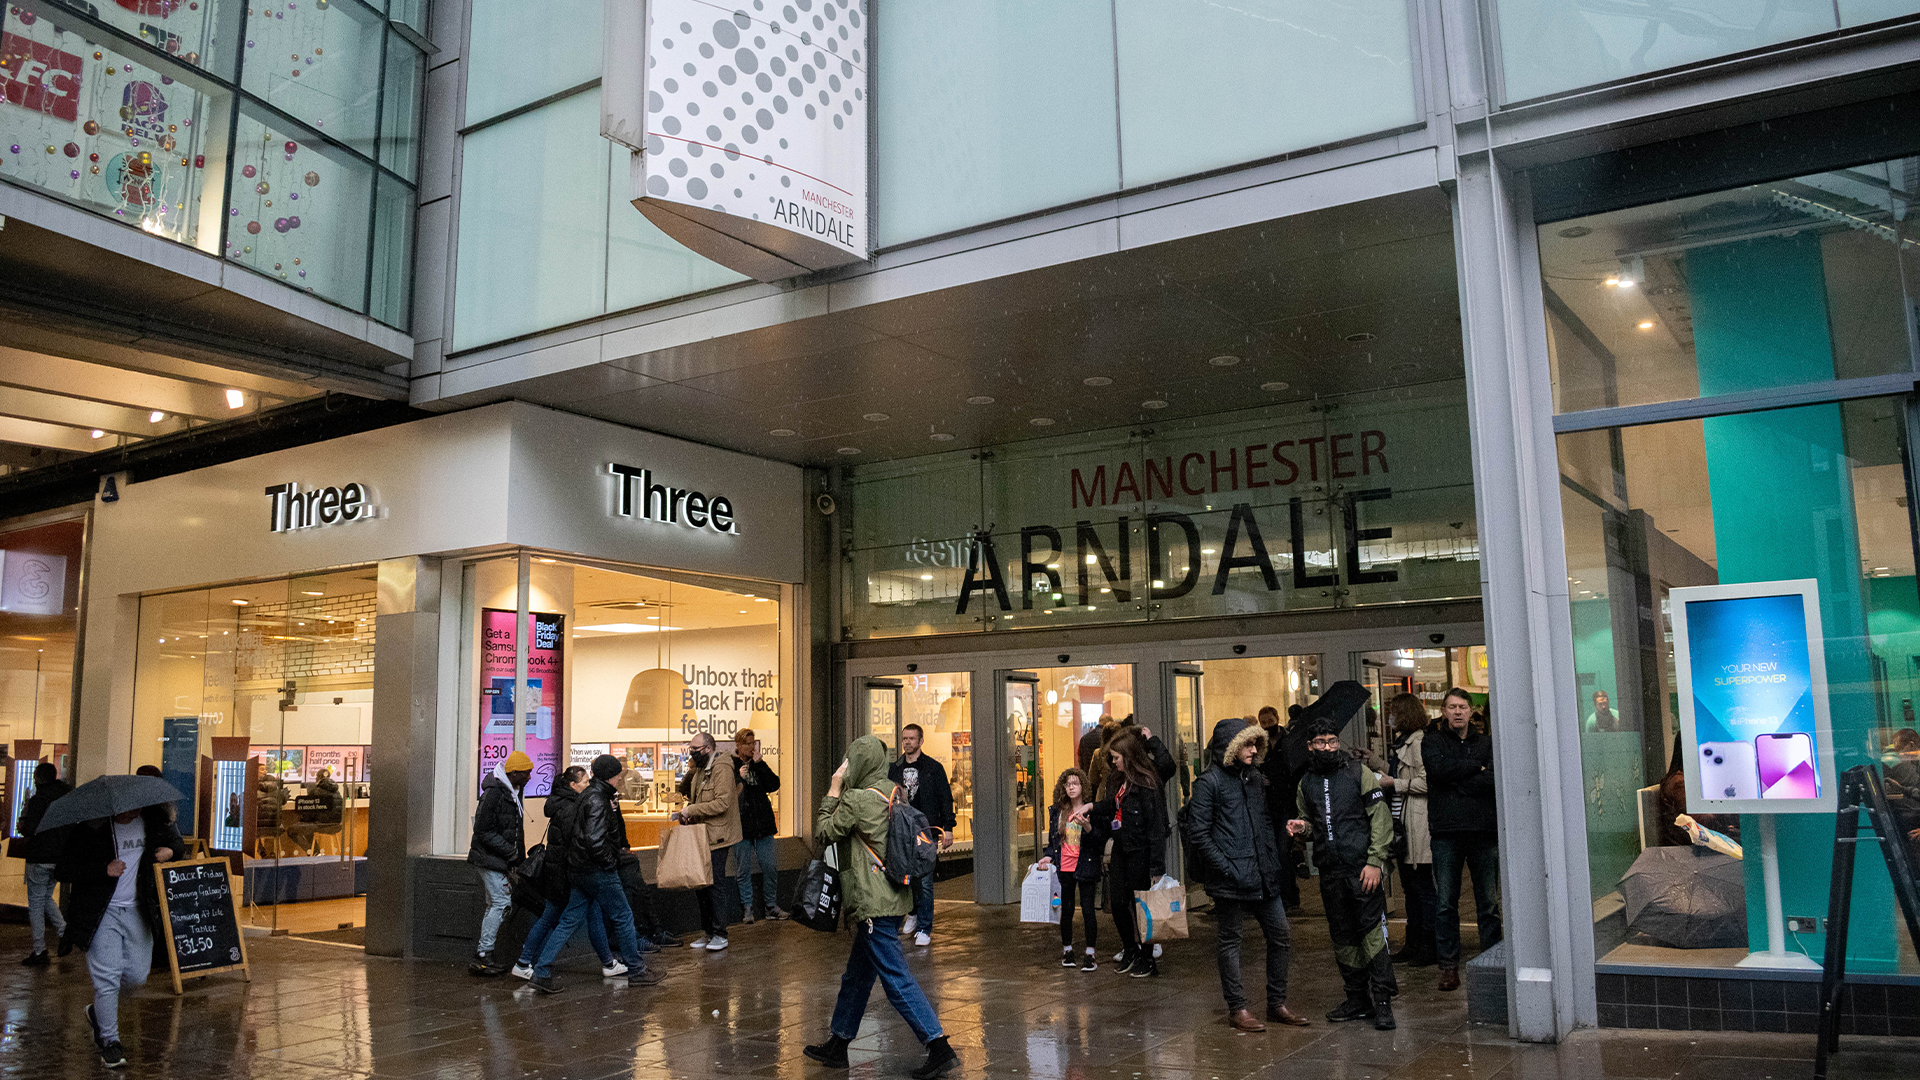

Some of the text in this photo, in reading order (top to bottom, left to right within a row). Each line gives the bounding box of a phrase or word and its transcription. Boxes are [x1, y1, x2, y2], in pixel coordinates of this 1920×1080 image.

[801, 188, 855, 220] MANCHESTER
[773, 198, 855, 248] ARNDALE
[1070, 429, 1390, 509] MANCHESTER
[955, 486, 1399, 615] ARNDALE
[536, 621, 558, 632] Black
[485, 627, 510, 640] Get a
[536, 631, 560, 642] Friday
[536, 639, 554, 648] Deal
[485, 653, 559, 666] Chromook 4+
[1721, 661, 1778, 674] YOUR NEW
[682, 663, 773, 689] Unbox that
[1714, 673, 1787, 686] SUPERPOWER
[681, 688, 784, 717] Black Friday
[680, 713, 738, 740] feeling
[309, 750, 315, 758] 6
[315, 750, 341, 758] months
[483, 744, 508, 759] £30
[309, 757, 340, 766] half price
[196, 866, 225, 882] Friday
[167, 888, 198, 901] Samsung
[169, 911, 200, 924] Samsung
[189, 924, 218, 934] Tablet
